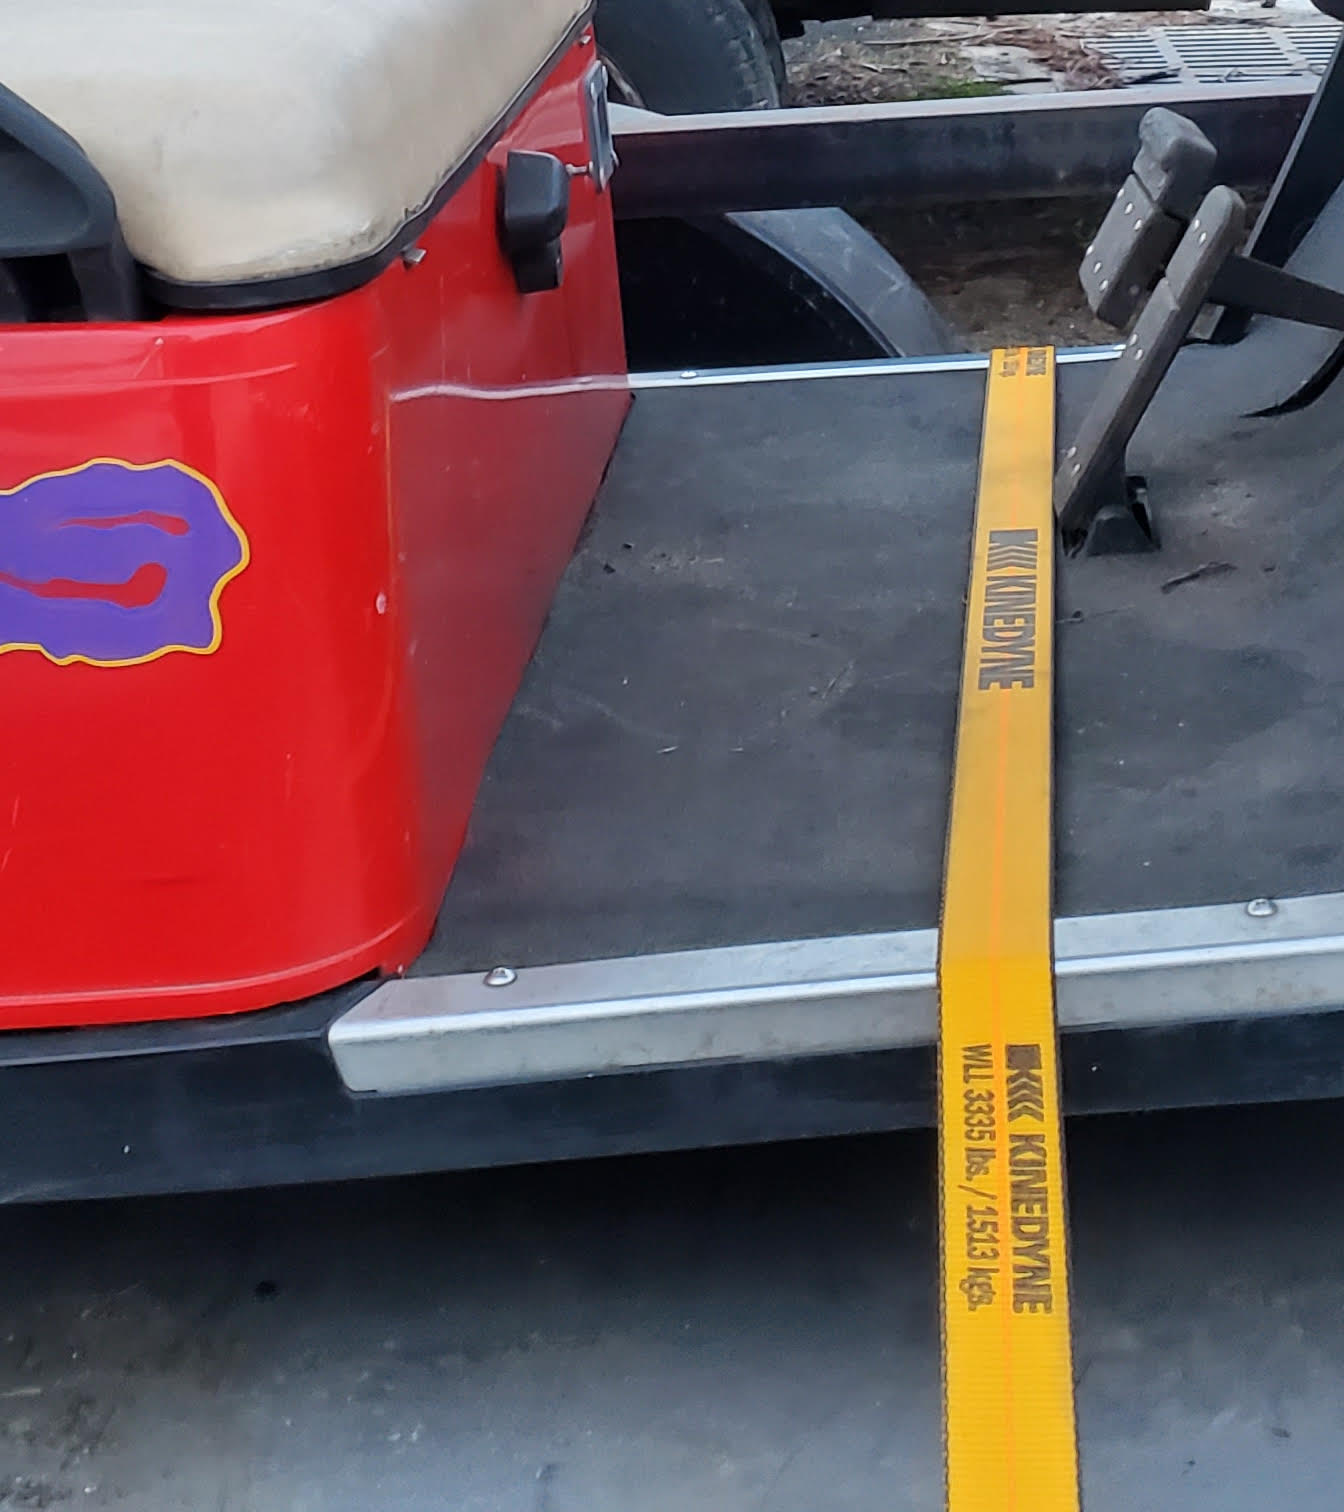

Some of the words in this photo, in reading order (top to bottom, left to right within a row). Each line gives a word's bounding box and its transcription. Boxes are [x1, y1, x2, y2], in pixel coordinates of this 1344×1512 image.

[978, 574, 1039, 690] KINEDYNE
[962, 1043, 994, 1084] WLL
[963, 1088, 996, 1141] 3335
[967, 1205, 1001, 1260] 1513
[1009, 1133, 1053, 1314] KINEDYNE
